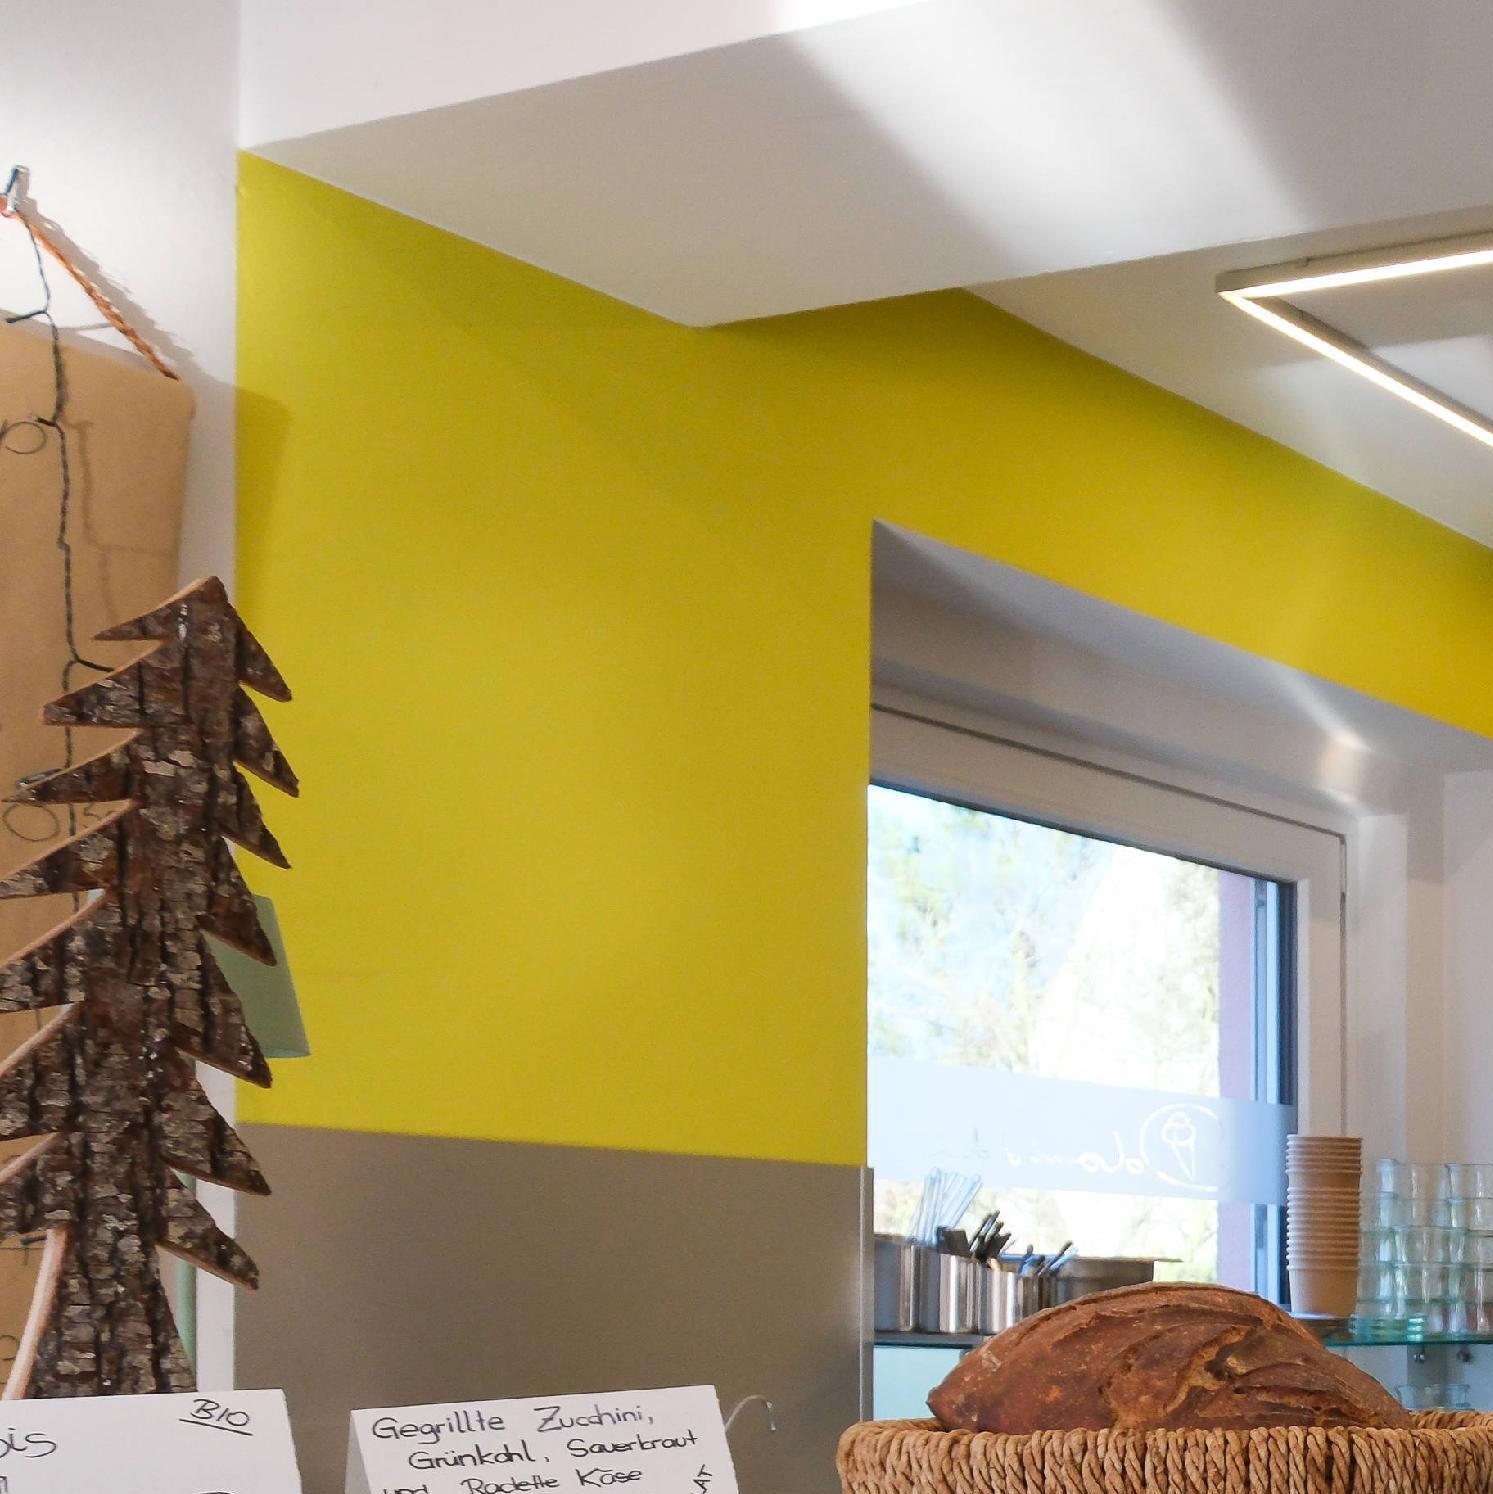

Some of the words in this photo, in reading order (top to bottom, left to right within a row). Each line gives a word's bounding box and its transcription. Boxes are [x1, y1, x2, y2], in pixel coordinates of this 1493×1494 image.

[191, 1399, 250, 1427] BIO
[372, 1410, 505, 1445] Gegrillte
[533, 1402, 655, 1433] Zucchini,
[408, 1439, 550, 1470] Grünkohl,
[566, 1430, 699, 1459] Sauerkraut
[576, 1467, 643, 1488] Käse
